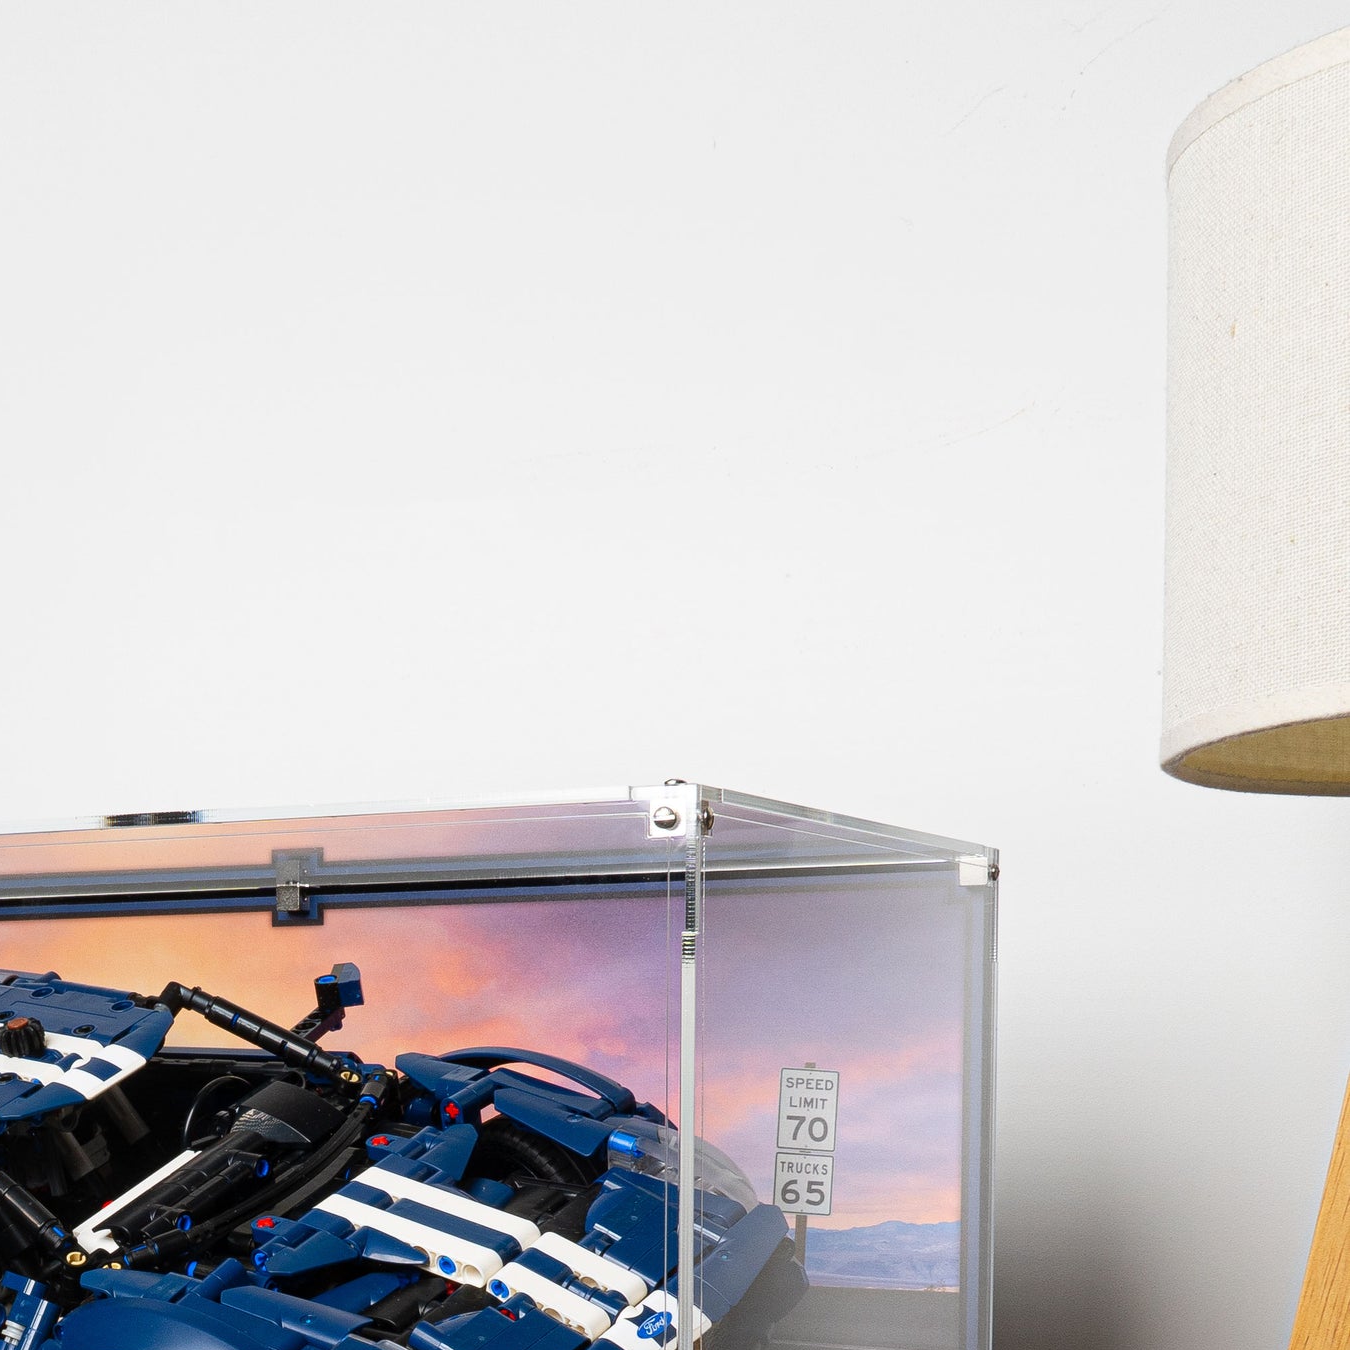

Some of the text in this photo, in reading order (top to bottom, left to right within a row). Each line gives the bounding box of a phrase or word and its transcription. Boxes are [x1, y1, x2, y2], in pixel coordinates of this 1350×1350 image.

[786, 1077, 834, 1091] SPEED
[789, 1096, 828, 1110] LIMIT
[786, 1115, 829, 1143] 70
[780, 1161, 829, 1176] TRUCKS
[780, 1179, 826, 1207] 65
[643, 1315, 666, 1336] Ford
